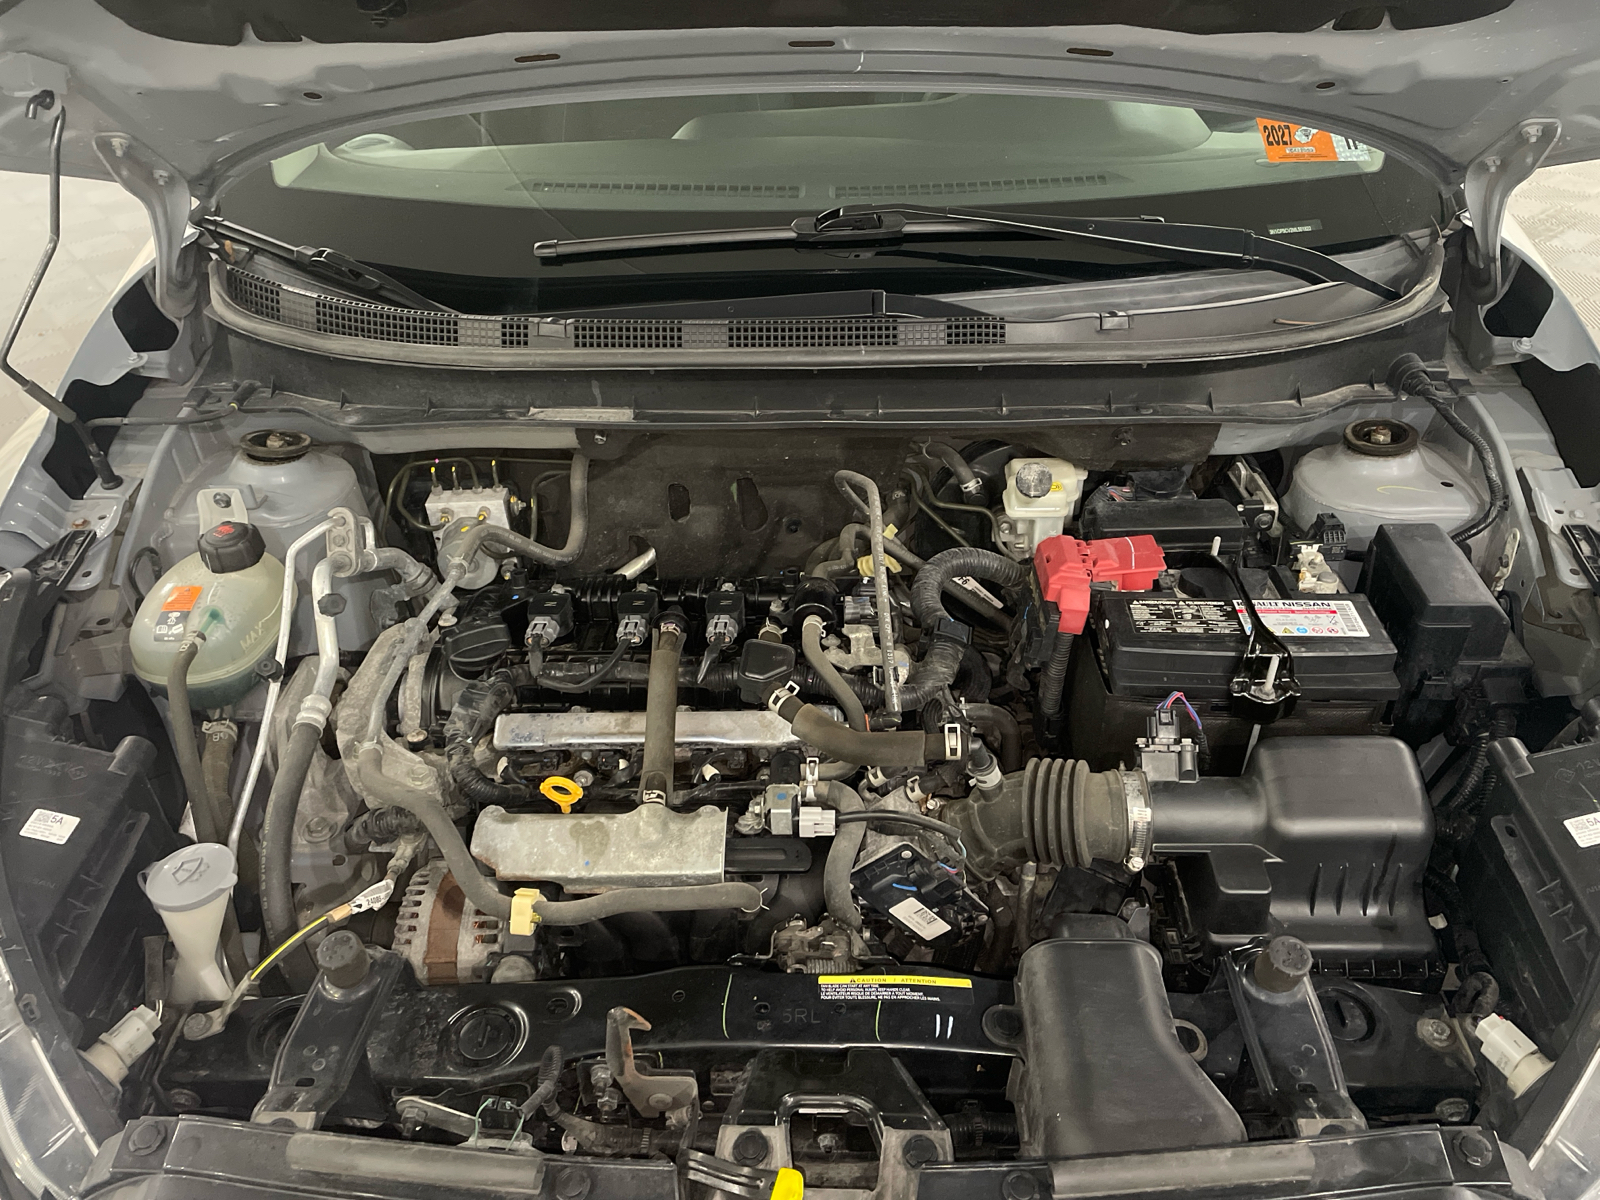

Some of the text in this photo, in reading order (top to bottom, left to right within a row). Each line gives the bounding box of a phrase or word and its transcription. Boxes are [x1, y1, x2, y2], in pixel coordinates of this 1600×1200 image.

[1263, 124, 1292, 146] 2027
[240, 620, 265, 654] MAX
[50, 815, 64, 825] 5A
